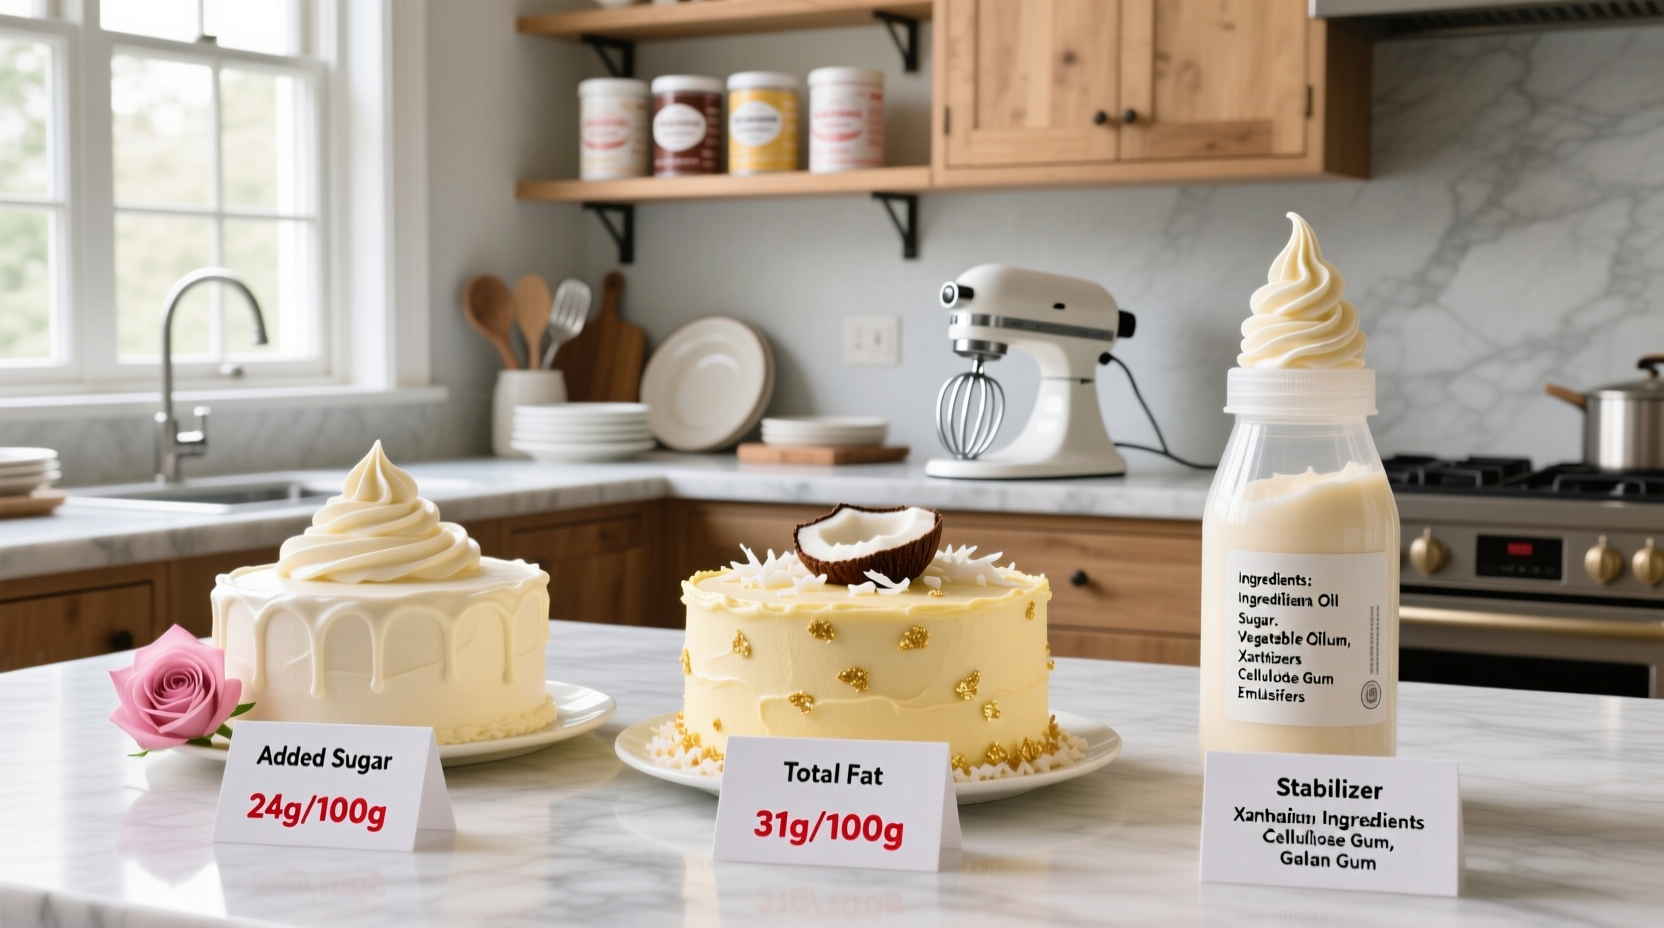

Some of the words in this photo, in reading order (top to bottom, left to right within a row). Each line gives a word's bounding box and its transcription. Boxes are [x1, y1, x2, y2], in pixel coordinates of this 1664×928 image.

[1302, 671, 1335, 686] Gum
[256, 745, 327, 768] Added
[331, 747, 394, 775] Sugar
[783, 761, 841, 784] Total
[846, 764, 884, 786] Fat
[1276, 777, 1384, 800] Stabilizer
[246, 792, 388, 833] 24g/100g
[1322, 810, 1426, 833] Ingredients
[753, 809, 905, 852] 31g/100g
[1350, 833, 1395, 853] Gum,
[1335, 853, 1378, 871] Gum
